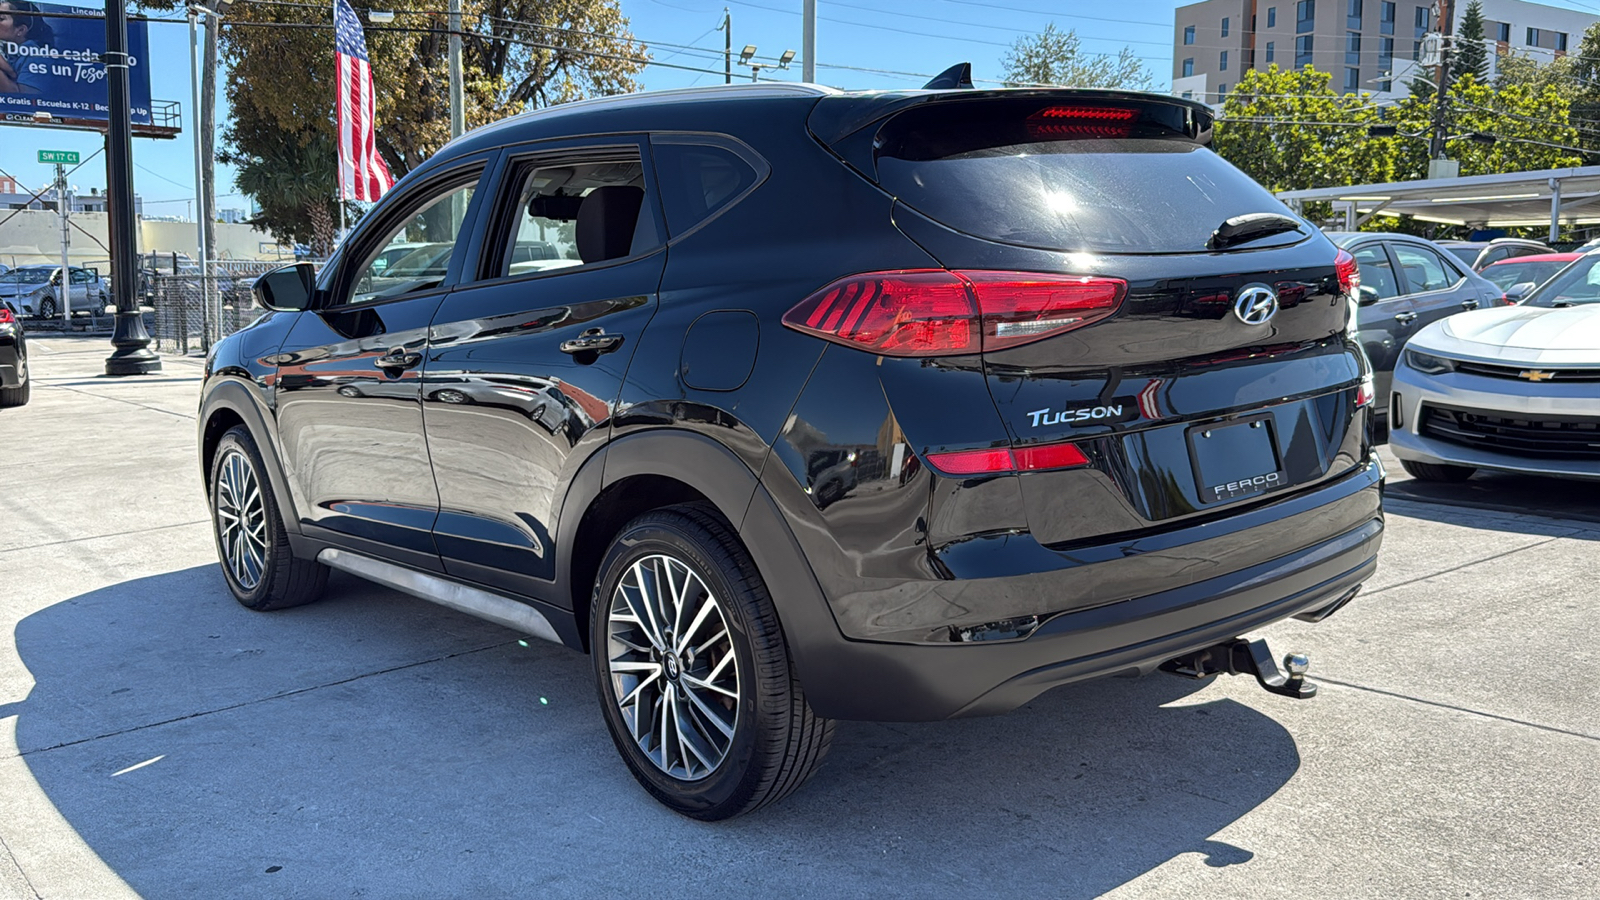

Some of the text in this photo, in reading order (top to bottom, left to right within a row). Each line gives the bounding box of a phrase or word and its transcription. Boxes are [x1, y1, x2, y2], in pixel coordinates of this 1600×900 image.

[7, 41, 59, 58] Donde
[28, 62, 48, 74] es
[51, 64, 72, 76] un
[7, 96, 31, 106] Gratis
[36, 99, 72, 109] Escuelas
[72, 102, 90, 110] K-12
[94, 103, 109, 111] Bec
[136, 107, 148, 116] Up
[42, 152, 77, 162] SW 17 Ct
[1214, 472, 1279, 495] FERCO
